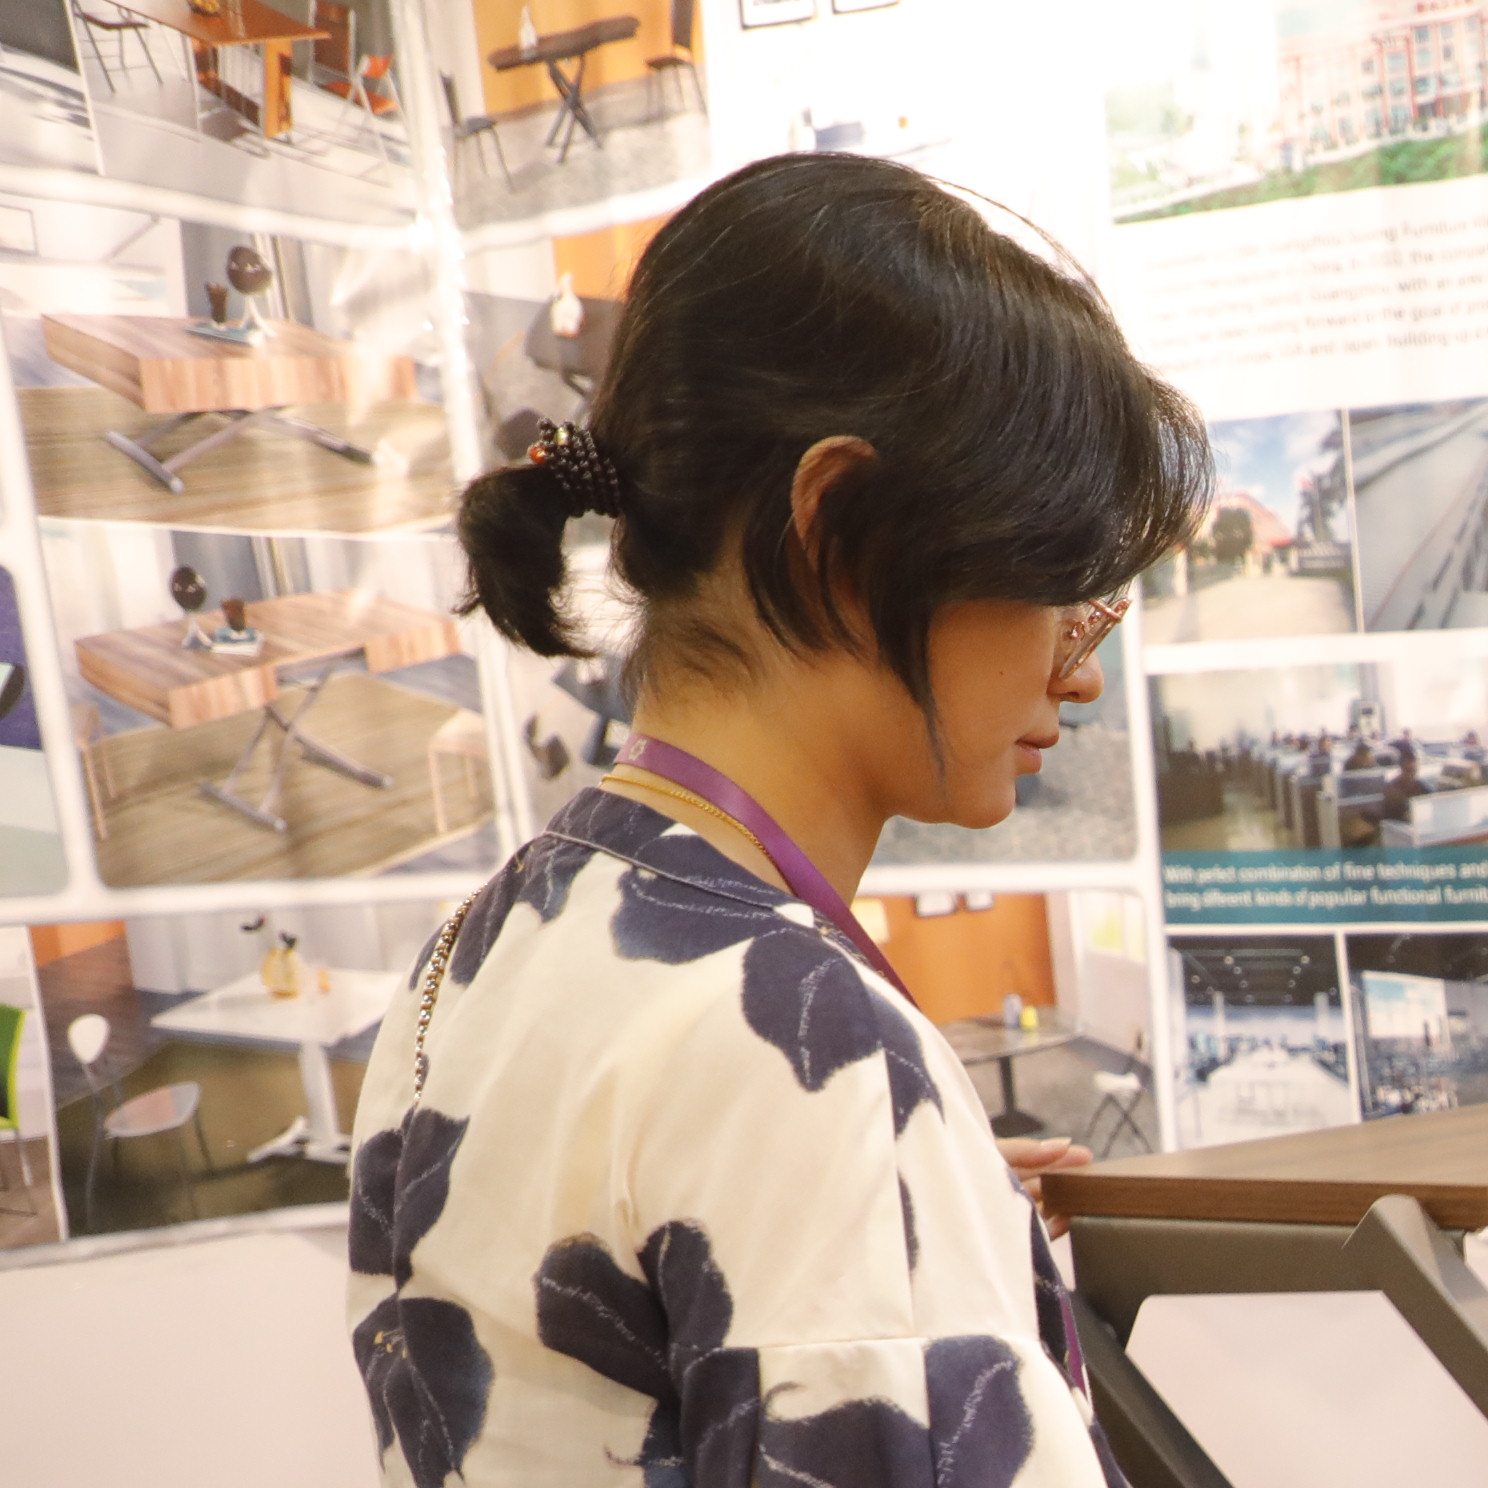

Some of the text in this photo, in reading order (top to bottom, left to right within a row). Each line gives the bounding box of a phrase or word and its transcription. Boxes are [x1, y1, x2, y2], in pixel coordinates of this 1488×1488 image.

[1411, 247, 1434, 264] the
[1398, 276, 1428, 294] with
[1323, 861, 1341, 881] of
[1343, 860, 1375, 880] fine
[1376, 859, 1457, 884] techniques
[1458, 858, 1488, 879] and
[1165, 888, 1202, 911] bring
[1254, 887, 1293, 907] kinds
[1294, 886, 1308, 906] of
[1308, 886, 1368, 911] popular
[1369, 884, 1442, 905] functional
